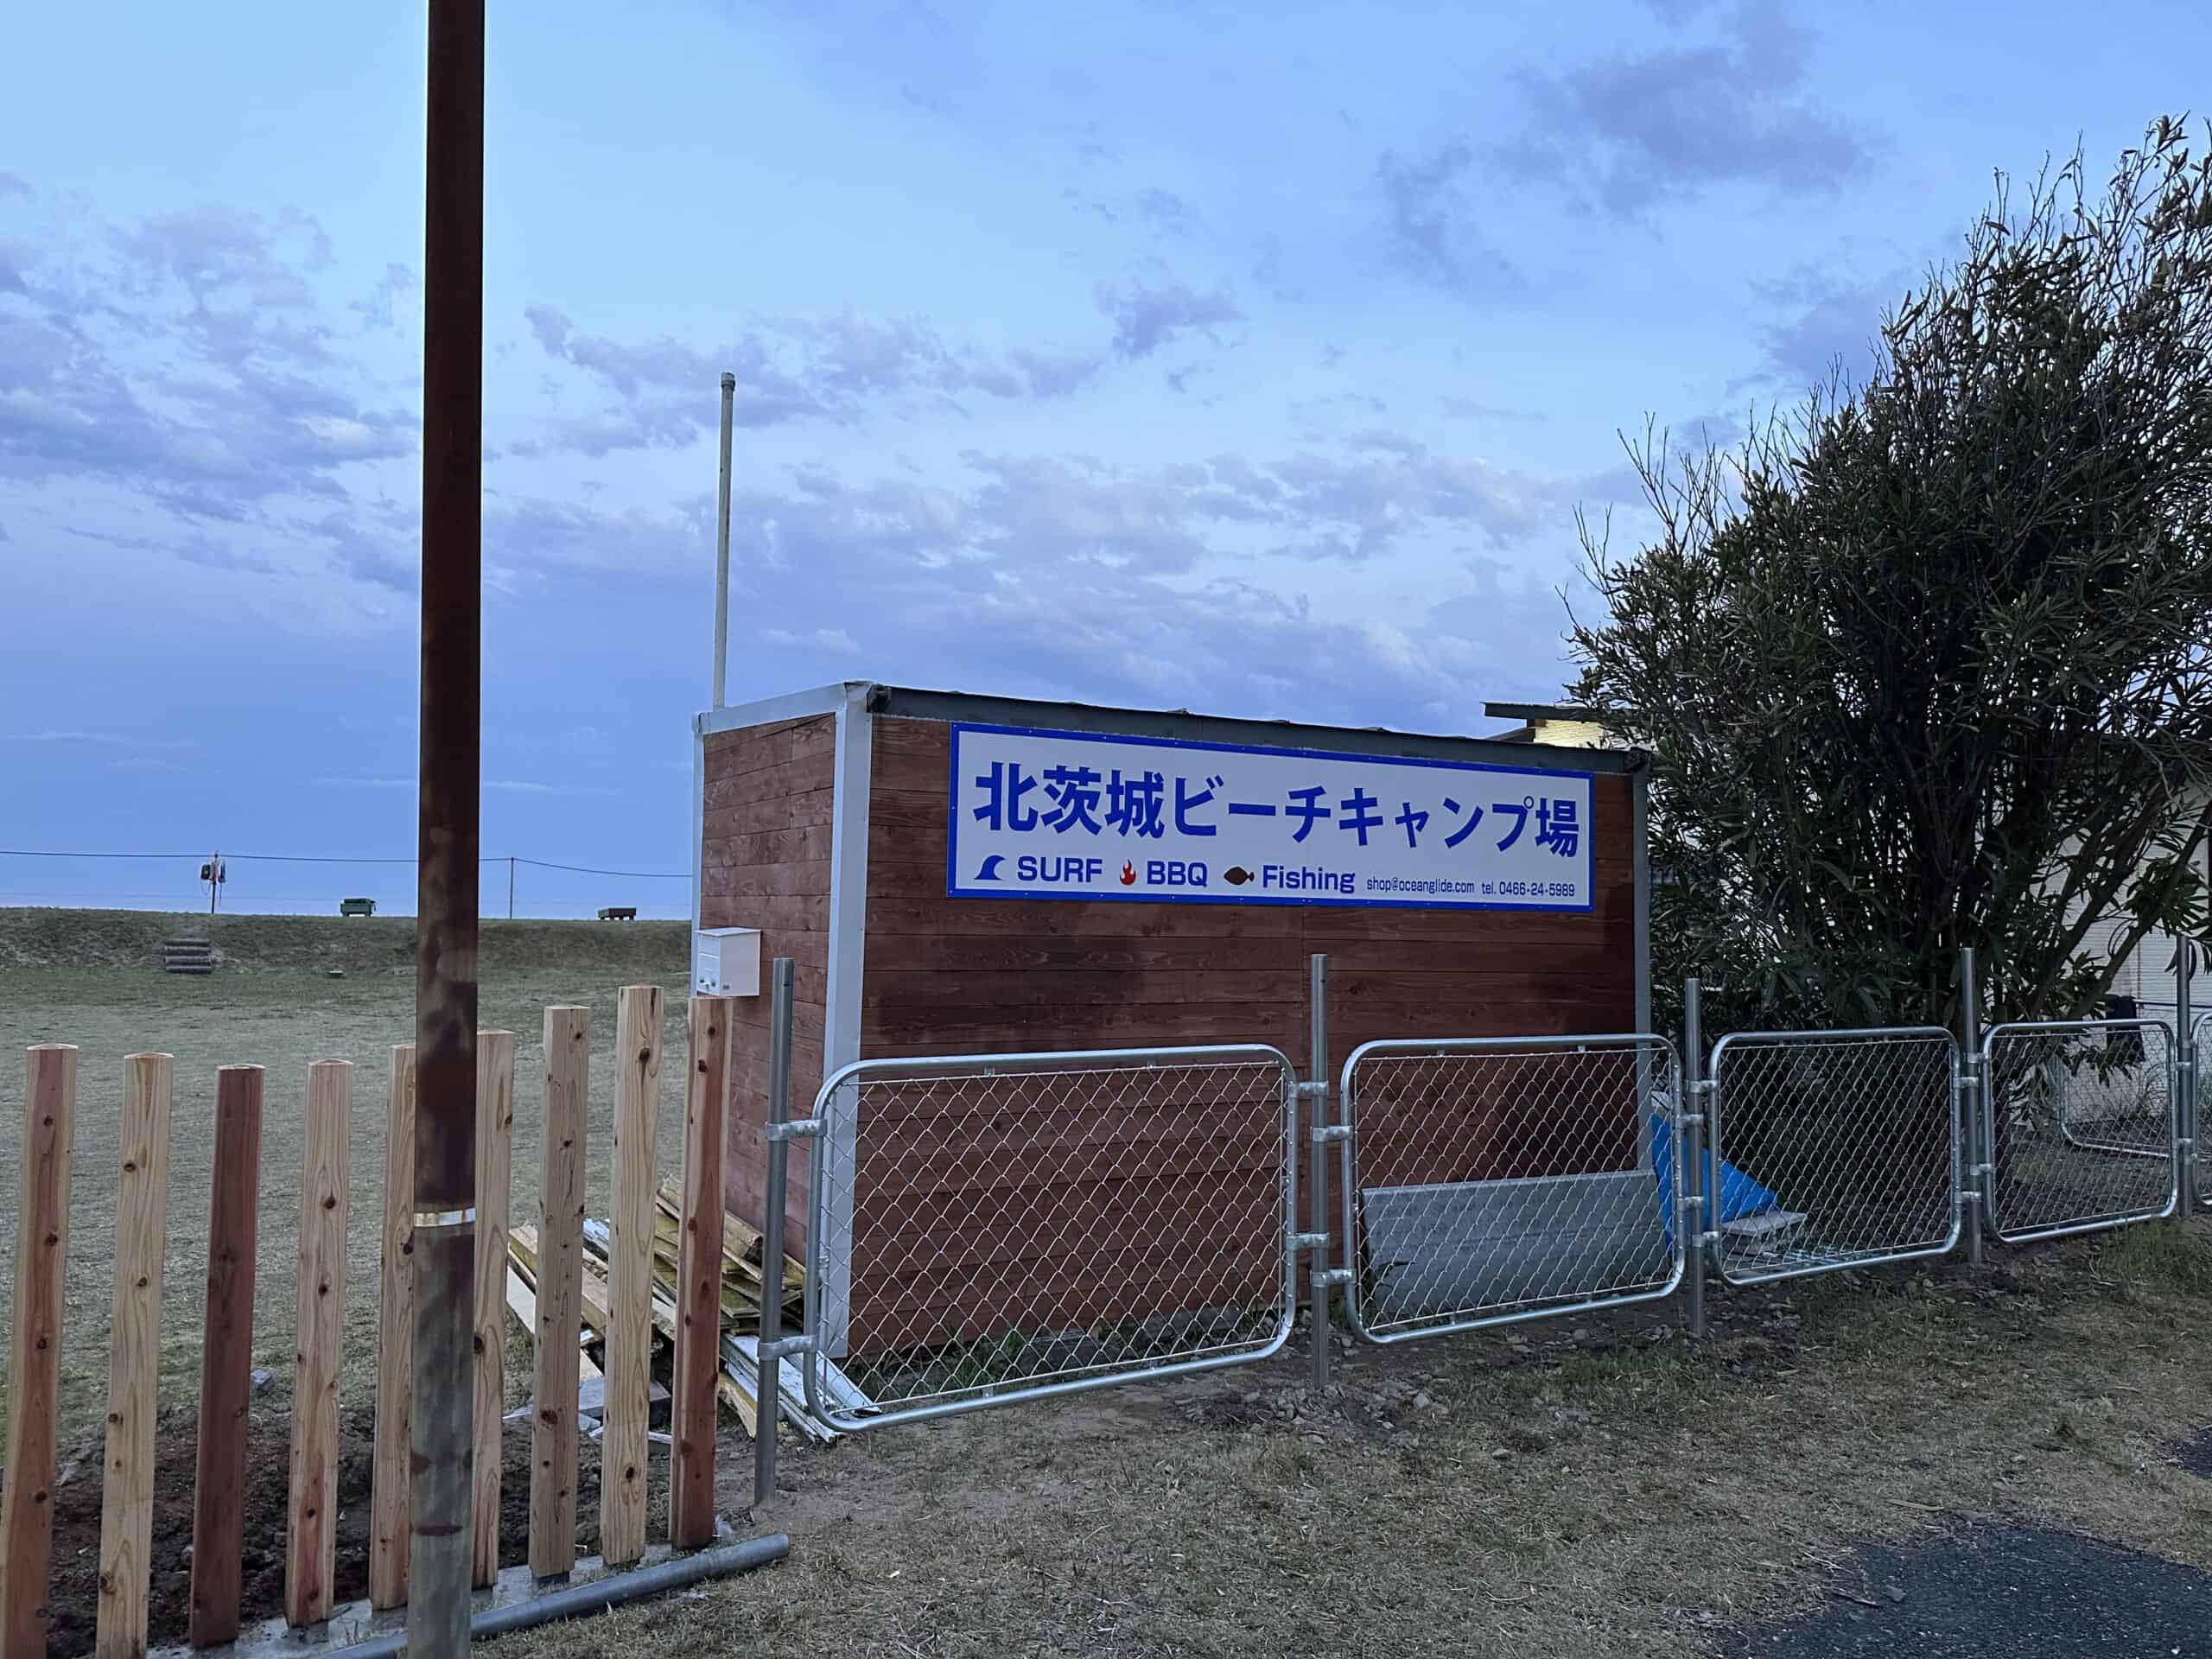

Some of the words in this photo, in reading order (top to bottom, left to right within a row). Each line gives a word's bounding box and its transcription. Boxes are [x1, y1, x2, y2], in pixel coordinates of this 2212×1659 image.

[974, 761, 1580, 858] 北茨城ビーチキャンプ場
[1016, 855, 1103, 883] SURF
[1146, 861, 1208, 887] BBQ
[1262, 864, 1356, 894] Fishing
[1366, 877, 1475, 893] shop@oceanglide.com
[1481, 881, 1497, 894] tel.
[1499, 880, 1575, 897] 0466-24-5989
